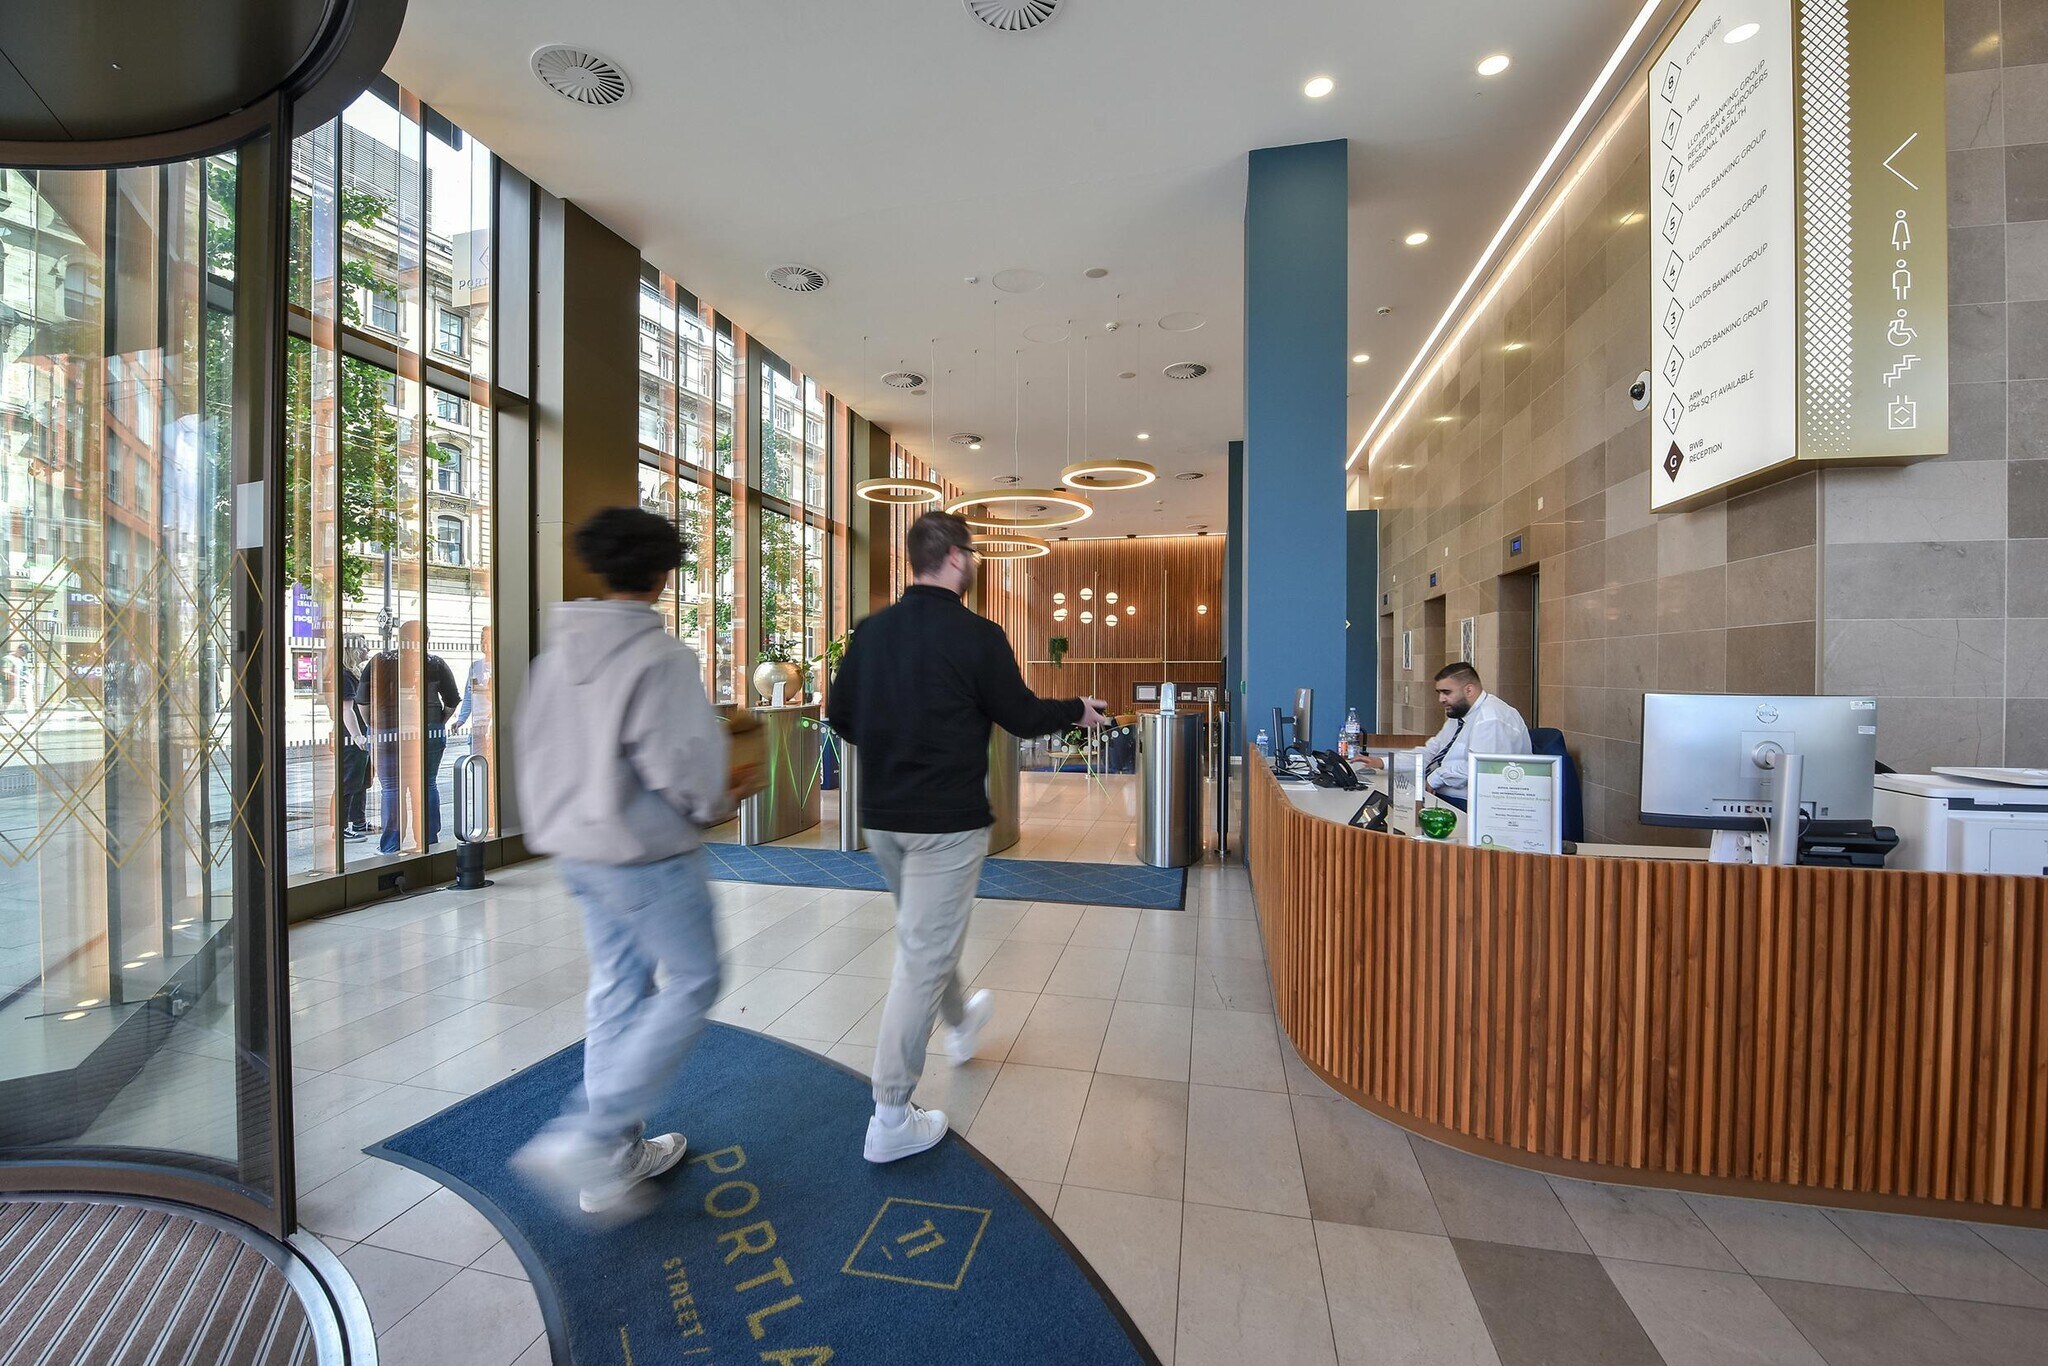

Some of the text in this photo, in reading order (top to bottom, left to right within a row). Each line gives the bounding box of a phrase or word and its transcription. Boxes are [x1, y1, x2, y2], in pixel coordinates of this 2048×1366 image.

[1686, 16, 1721, 64] ETC VENUES
[1668, 75, 1674, 90] 8
[1686, 94, 1700, 114] ARM
[1687, 59, 1766, 150] LLOYDS BANKING GROUP
[1687, 122, 1720, 160] RECEPTION
[1726, 69, 1769, 119] SCHRODERS
[1668, 121, 1674, 136] 7
[1687, 106, 1747, 173] PERSONAL WEALTH
[1669, 169, 1675, 183] 6
[1688, 129, 1767, 211] LLOYDS BANKING GROUP
[1670, 216, 1675, 231] 5
[1688, 184, 1768, 261] LLOYDS BANKING GROUP
[1669, 264, 1676, 277] 4
[1688, 242, 1768, 310] LLOYDS BANKING GROUP
[1670, 311, 1676, 326] 3
[1688, 299, 1769, 359] LLOYDS BANKING GROUP
[1670, 359, 1677, 373] 2
[1688, 388, 1703, 403] ARM
[1700, 395, 1710, 407] SQ
[1710, 389, 1718, 402] FT
[1718, 369, 1755, 397] AVAILABLE
[1671, 407, 1676, 420] 1
[1688, 442, 1723, 464] RECEPTION
[1689, 438, 1704, 452] BWB
[1669, 454, 1677, 468] G
[662, 1257, 704, 1338] STREET
